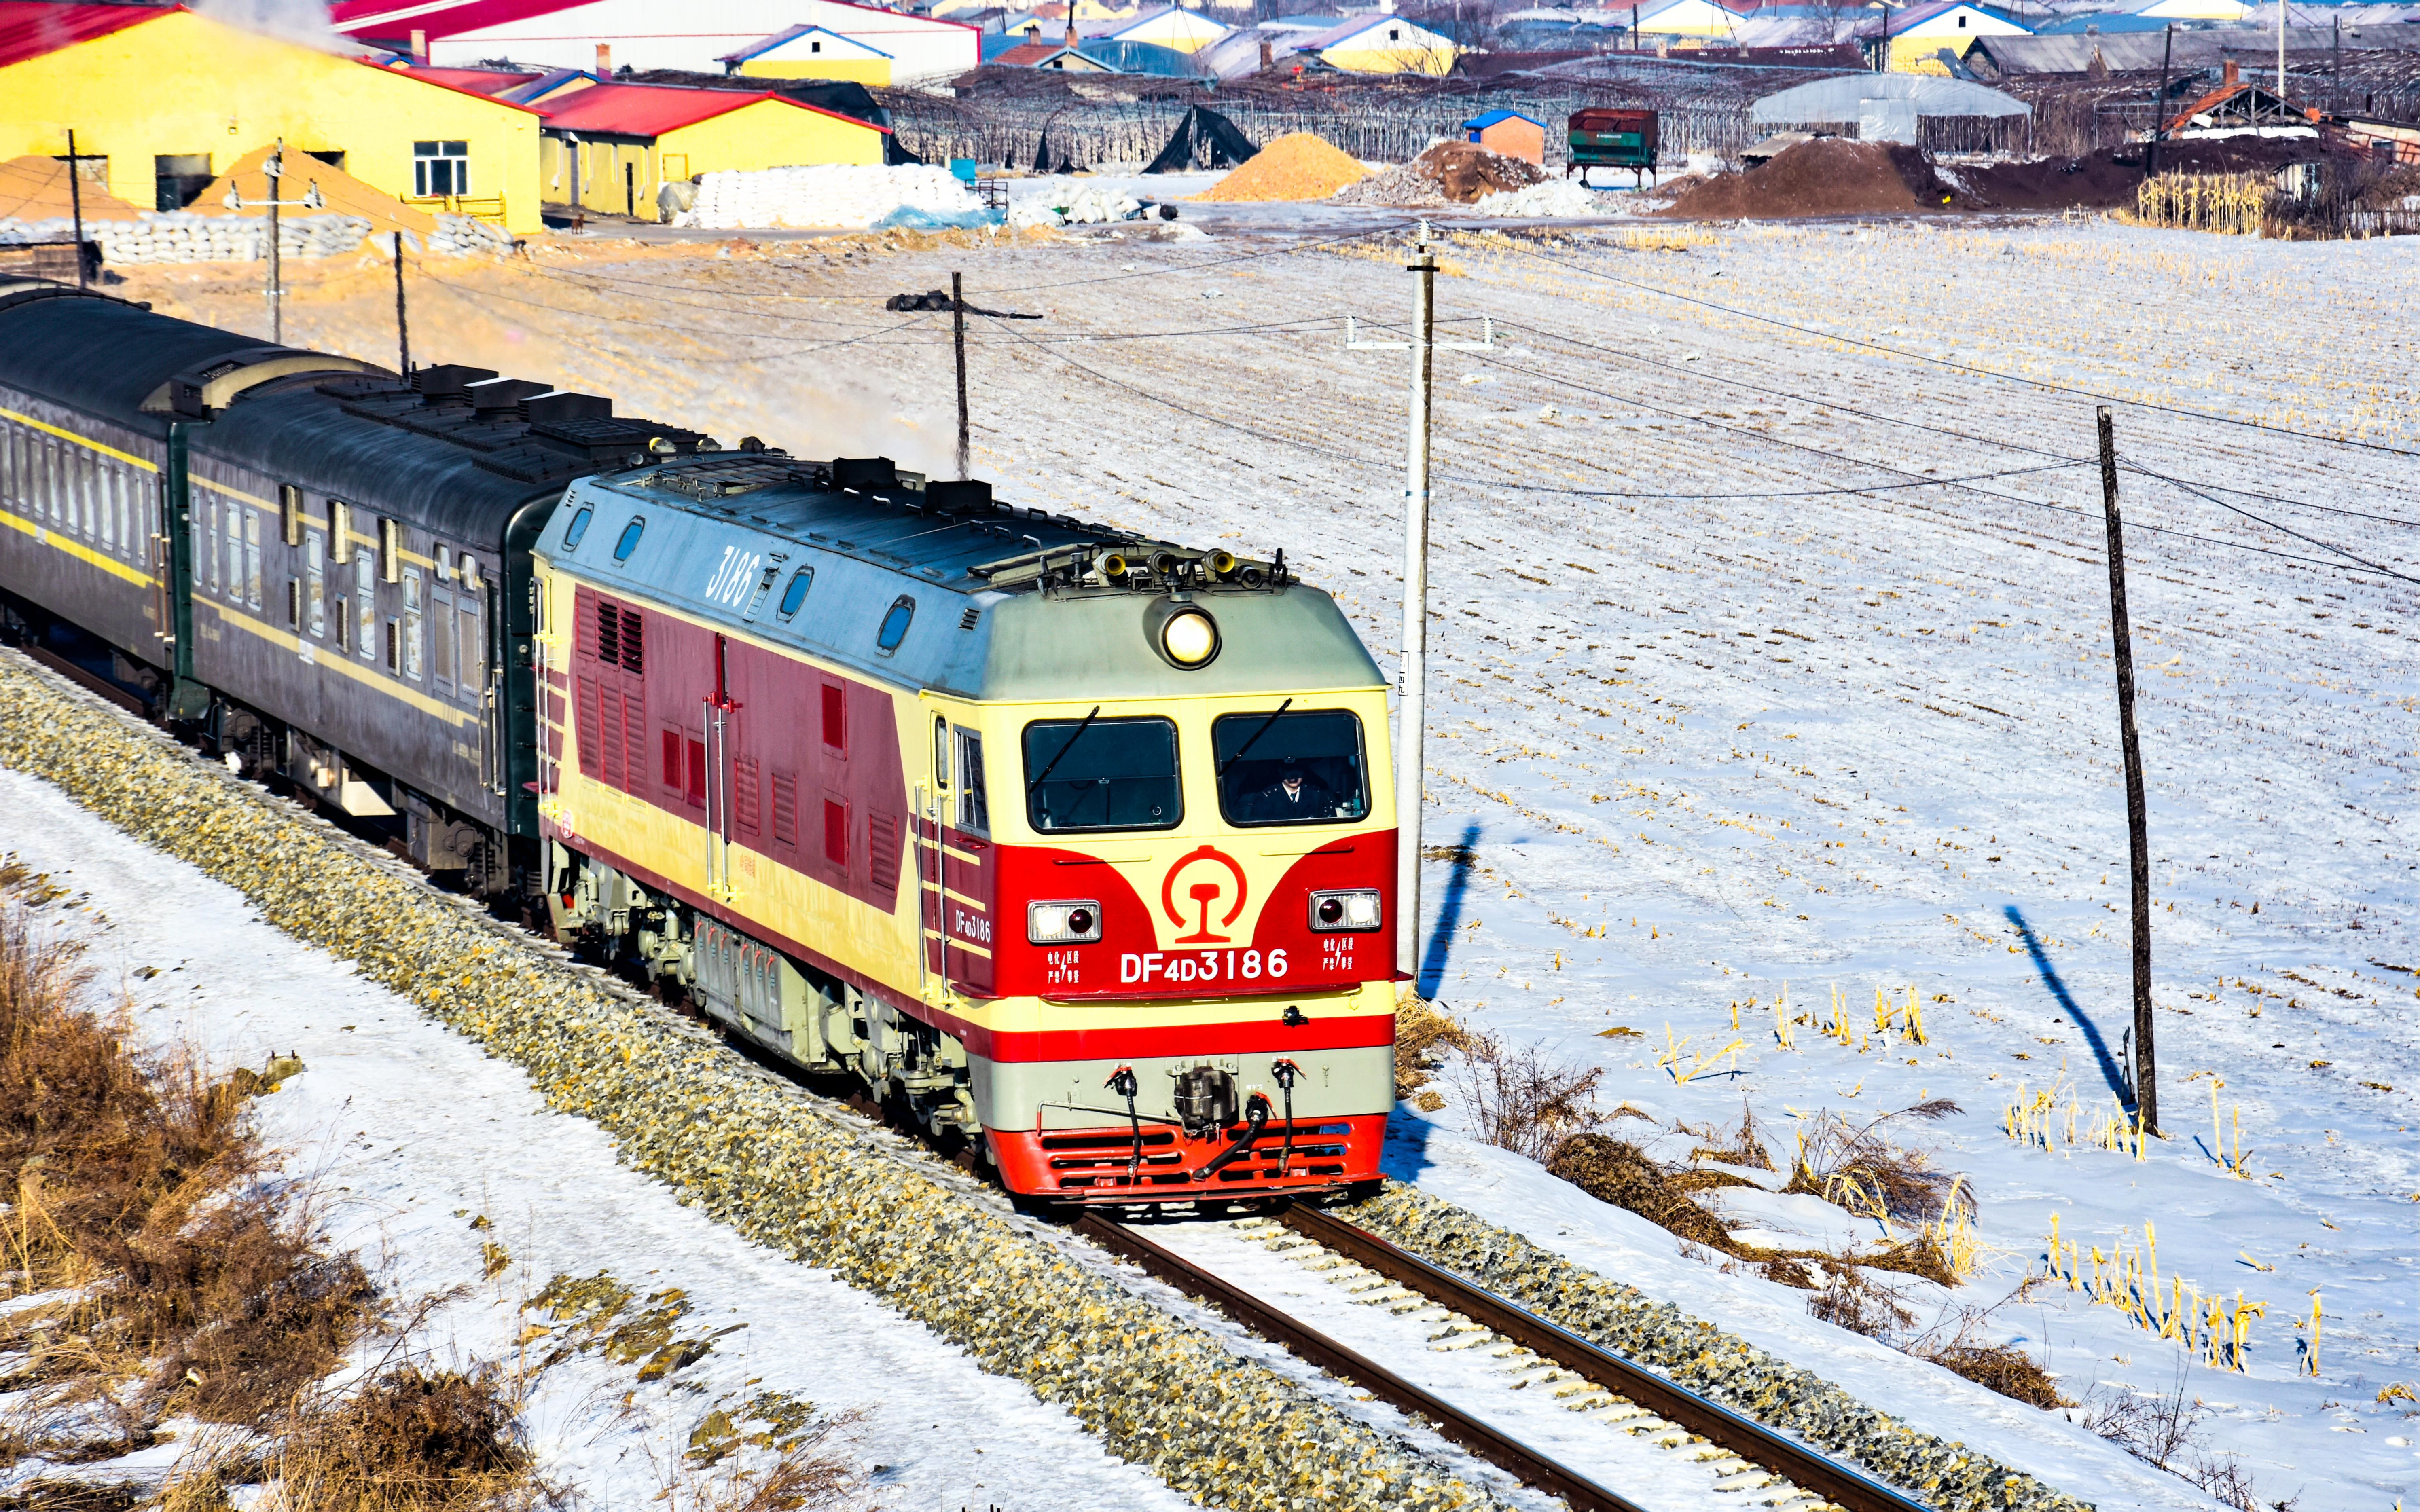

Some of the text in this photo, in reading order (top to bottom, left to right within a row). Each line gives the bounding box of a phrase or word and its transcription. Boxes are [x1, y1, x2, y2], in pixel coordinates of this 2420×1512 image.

[706, 545, 760, 607] 3186
[956, 909, 990, 943] DF4D3186
[1121, 949, 1288, 983] DF4D3186
